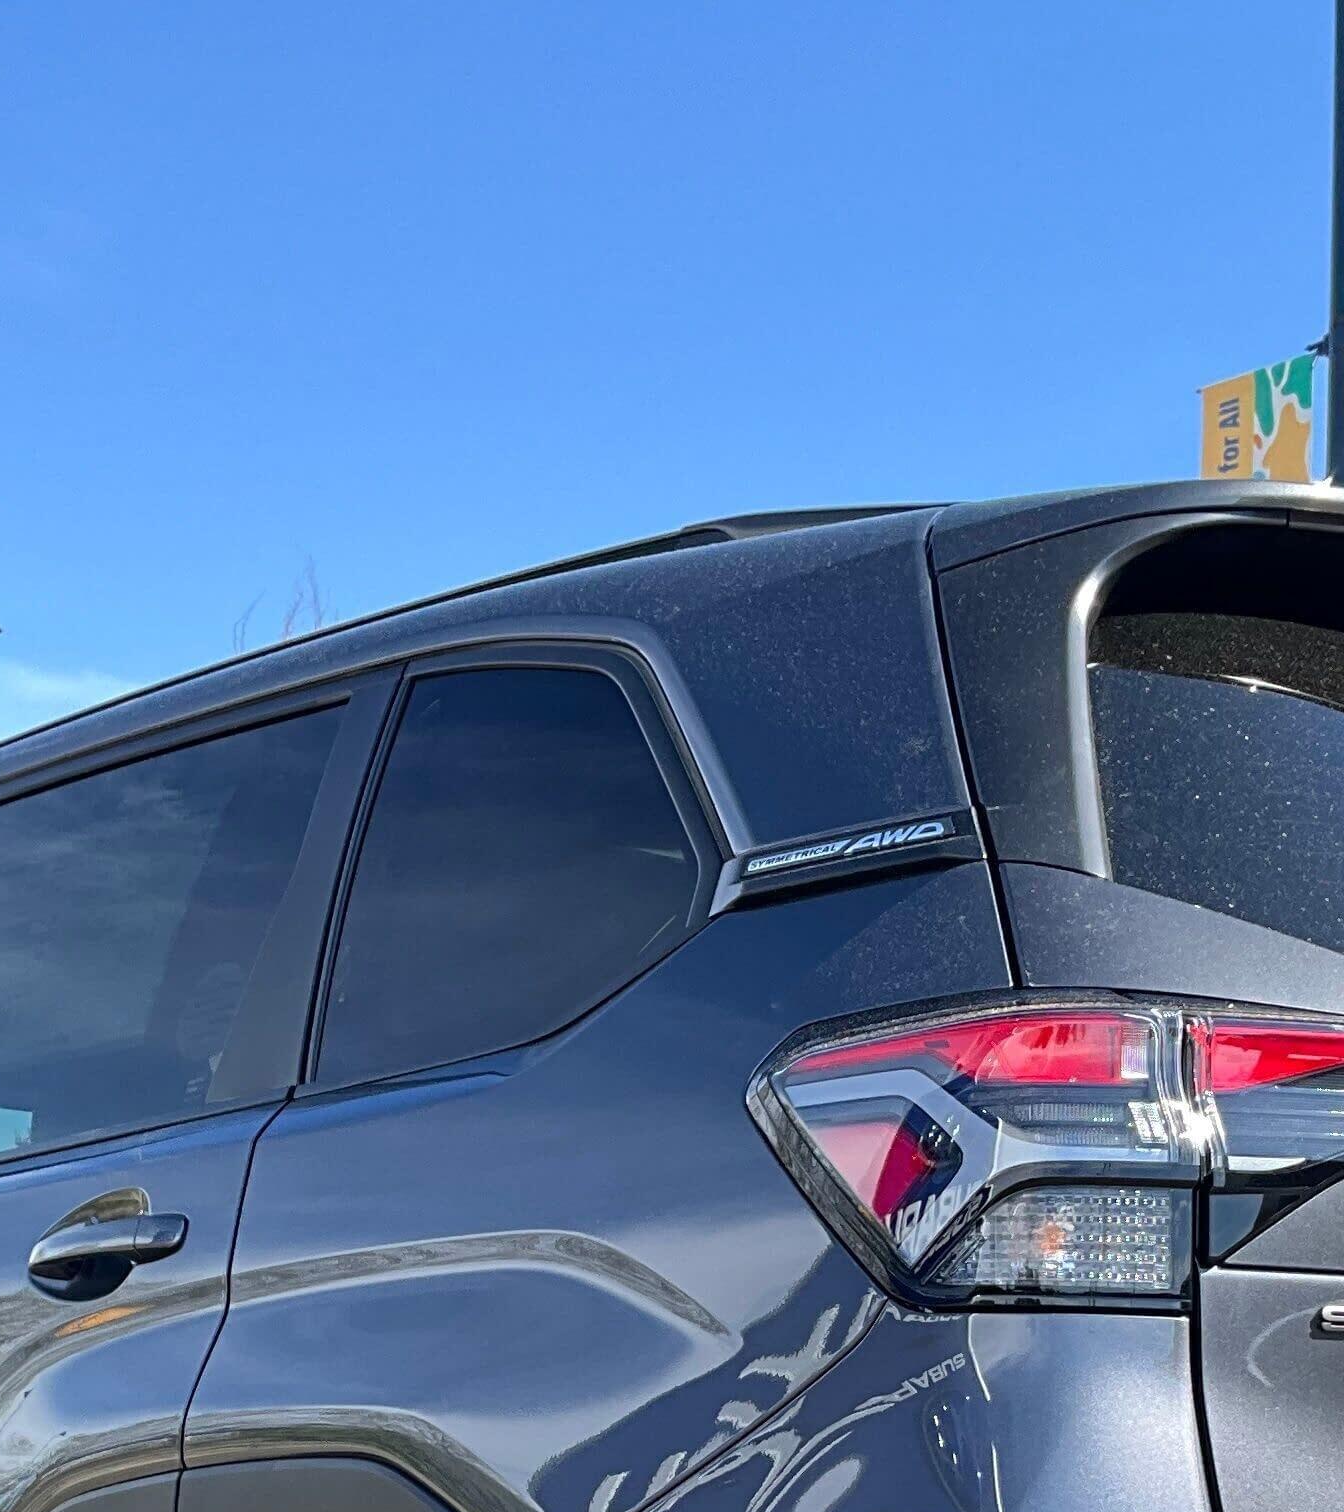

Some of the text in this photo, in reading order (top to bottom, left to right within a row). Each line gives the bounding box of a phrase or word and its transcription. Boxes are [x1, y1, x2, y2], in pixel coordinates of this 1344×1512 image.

[1217, 398, 1240, 474] for All
[749, 821, 945, 871] SYMMETRICAL AWD
